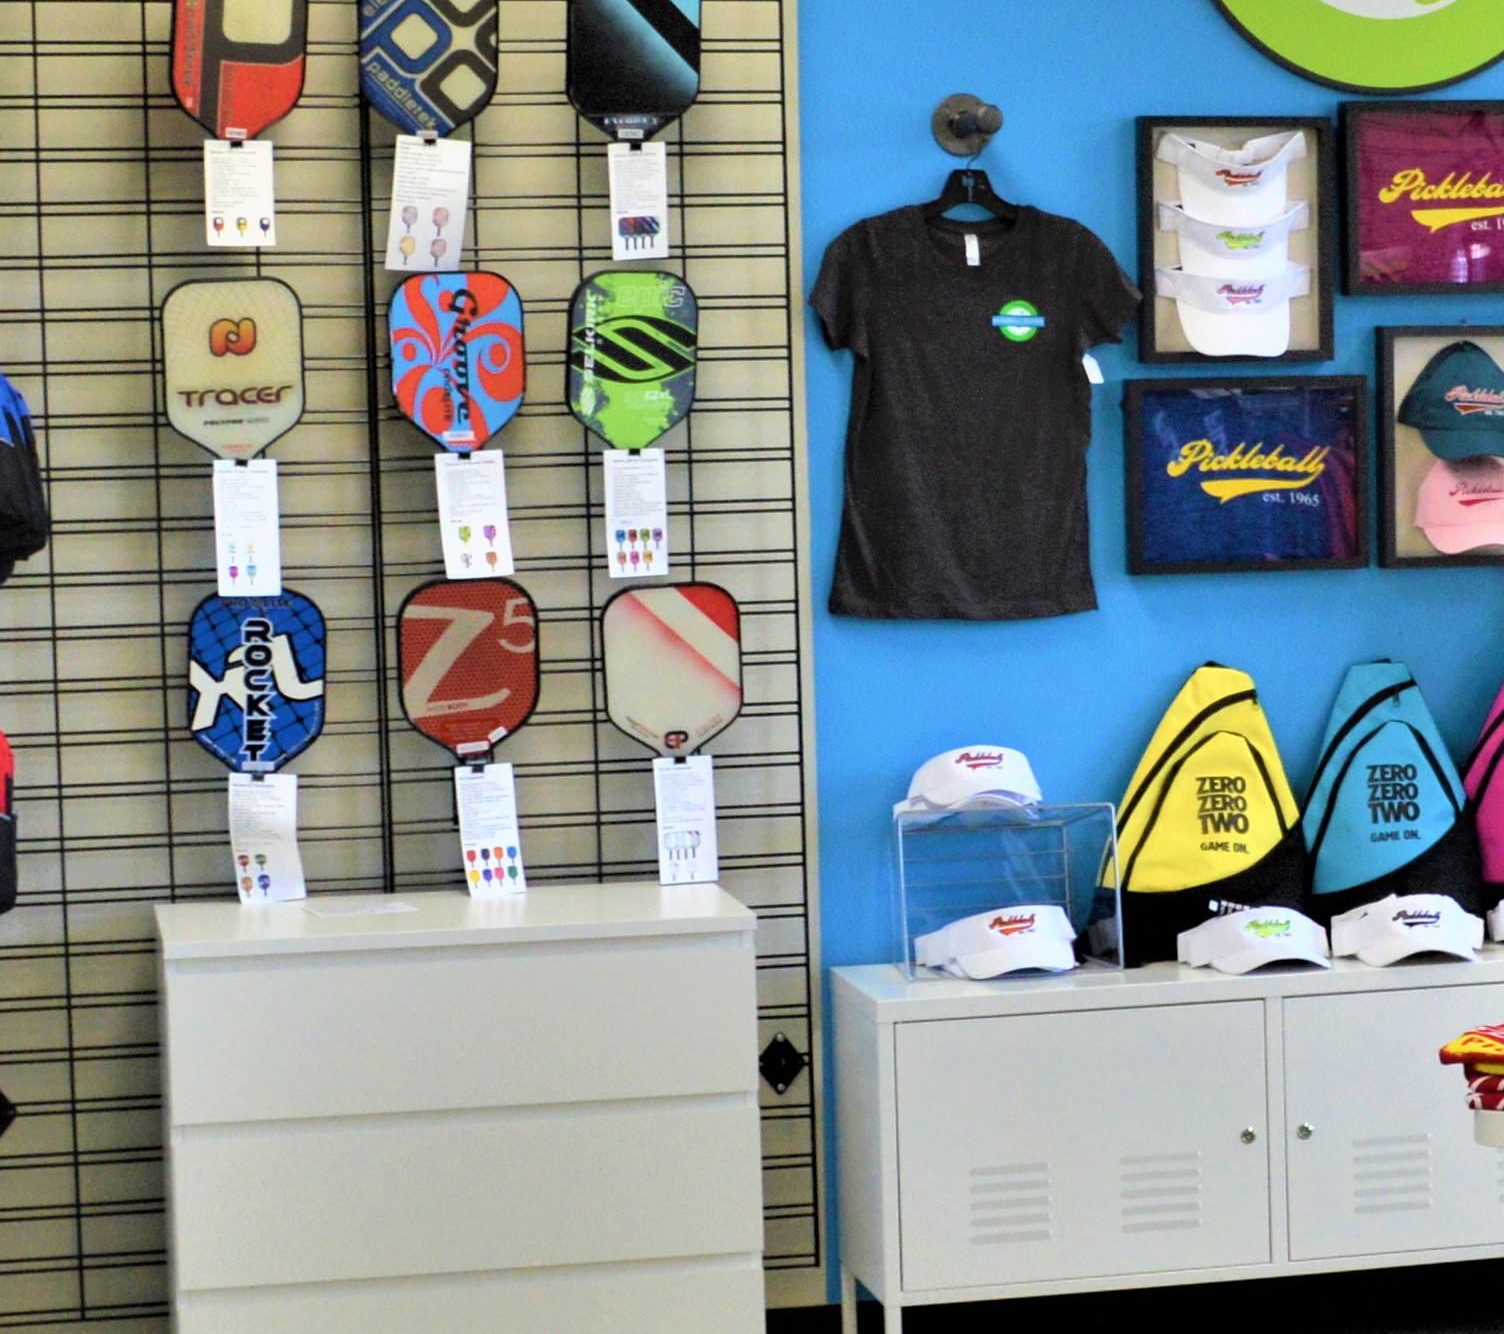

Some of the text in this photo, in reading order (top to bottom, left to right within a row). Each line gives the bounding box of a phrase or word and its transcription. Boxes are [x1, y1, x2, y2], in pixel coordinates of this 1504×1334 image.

[366, 62, 437, 130] paddletek
[1471, 219, 1492, 231] est.
[584, 290, 598, 382] SELKIRK
[449, 289, 478, 424] Groove
[1166, 439, 1327, 478] Pickleball
[1262, 490, 1321, 508] est. 1965
[239, 618, 278, 763] ROCKET
[1367, 765, 1417, 782] ZERO
[1196, 777, 1246, 795] ZERO
[1368, 782, 1419, 801] ZERO
[1199, 795, 1247, 813] ZERO
[1368, 802, 1420, 824] TWO
[1199, 814, 1250, 835] TWO
[1370, 830, 1400, 842] GAME
[1201, 841, 1230, 854] GAME
